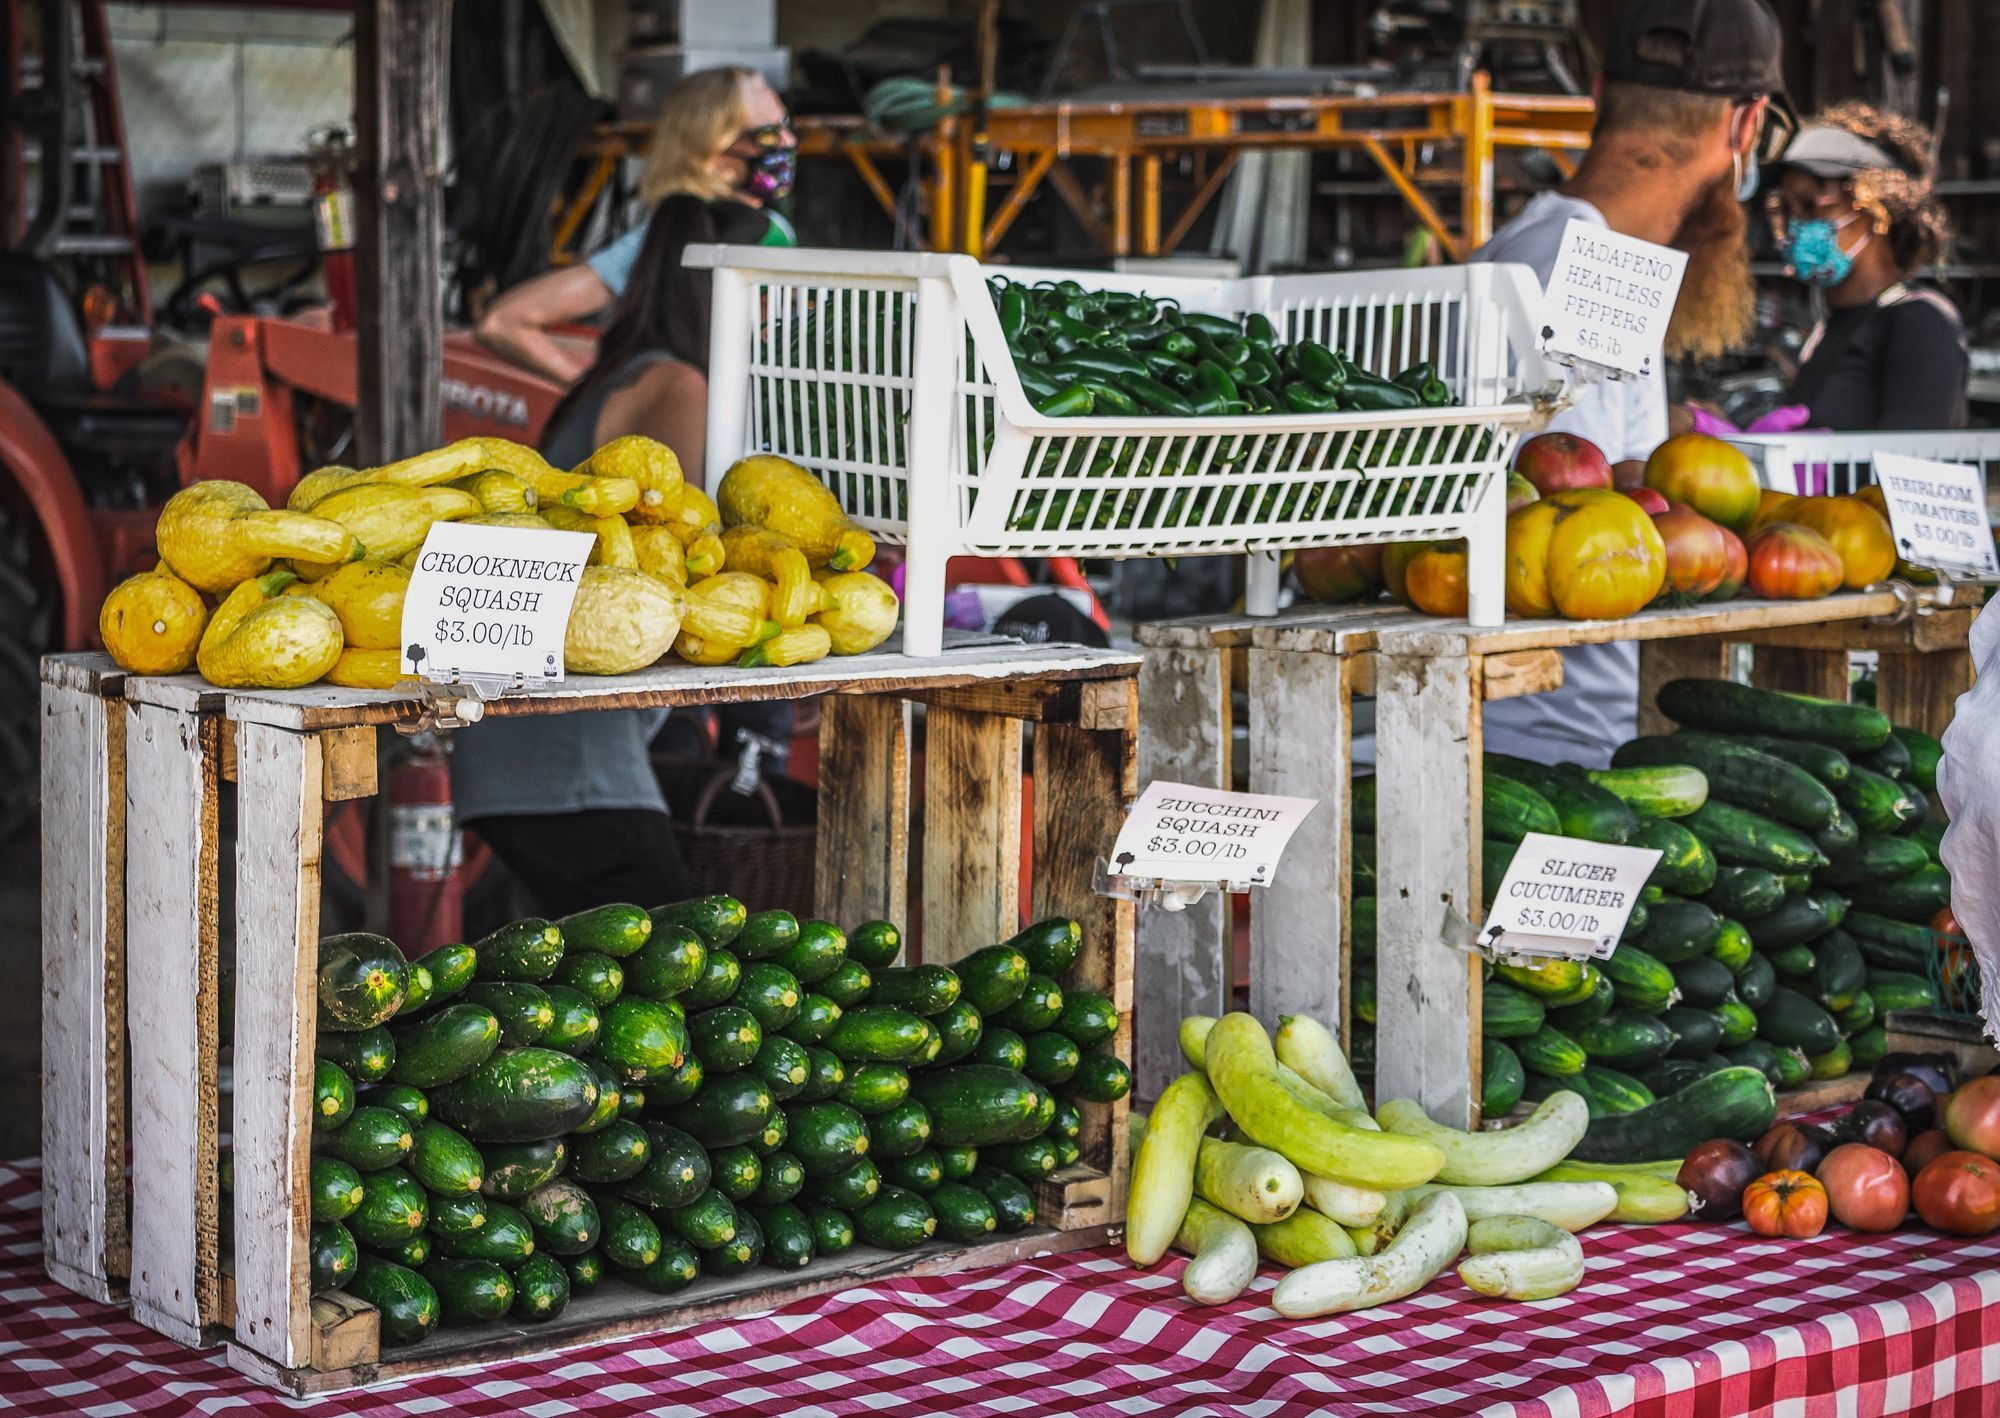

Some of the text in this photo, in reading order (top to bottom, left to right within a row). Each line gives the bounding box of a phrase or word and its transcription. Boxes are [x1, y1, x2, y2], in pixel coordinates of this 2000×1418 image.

[1572, 236, 1673, 282] NADAPEÑO
[1565, 265, 1662, 309] HEATLESS
[1564, 295, 1648, 334] PEPPERS
[1889, 476, 1975, 504] HEIRLOOM
[1895, 498, 1980, 527] TOMATOES
[1914, 522, 1975, 549] $300/lb
[421, 551, 581, 582] CROOKNECK
[439, 585, 543, 613] SQUASH
[435, 617, 534, 650] $3.00/lb
[1156, 798, 1283, 822] ZUCCHINI
[1156, 816, 1260, 838] SQUASH
[1147, 835, 1247, 861] $3.00/lb
[1541, 859, 1617, 883] SLICER
[1510, 881, 1625, 909] CUCUMBER
[1517, 907, 1599, 934] $3.00/lb
